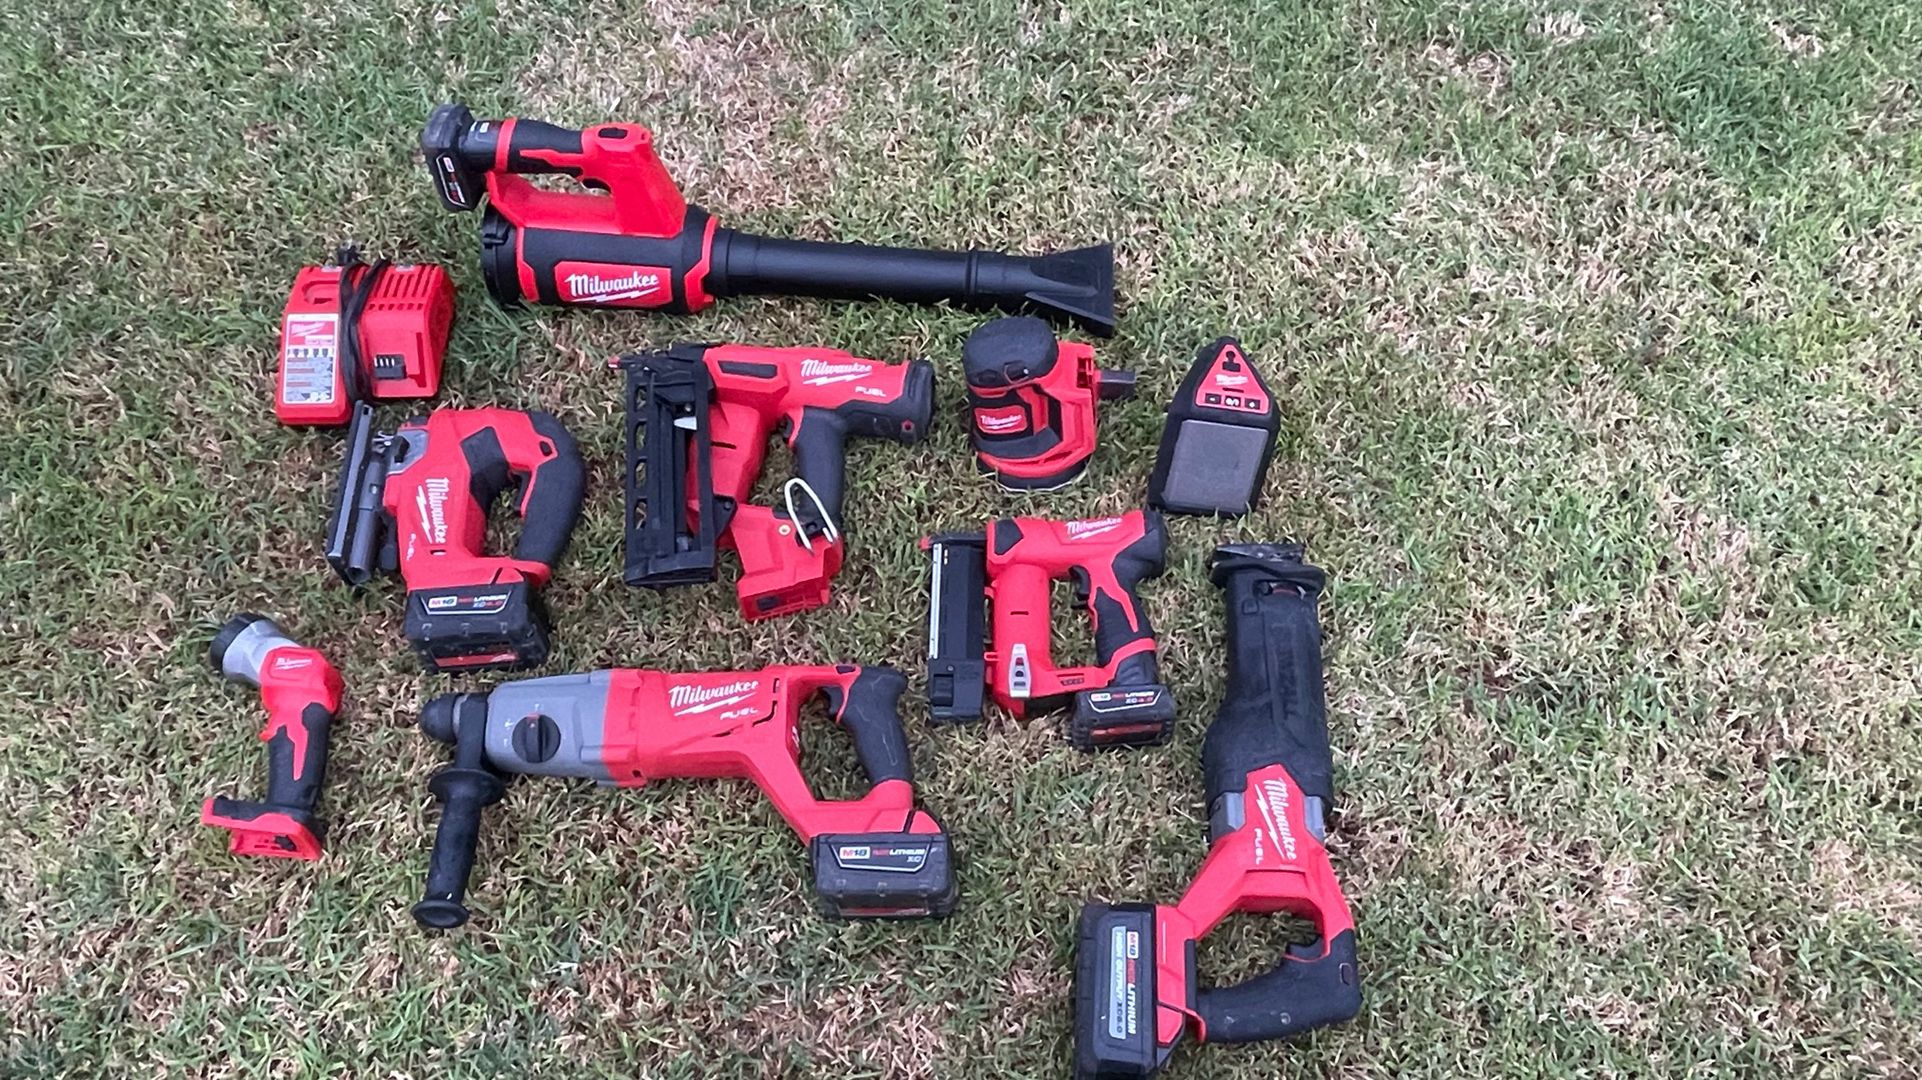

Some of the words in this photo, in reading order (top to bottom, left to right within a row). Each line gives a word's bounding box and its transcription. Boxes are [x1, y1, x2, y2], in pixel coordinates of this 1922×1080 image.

[564, 270, 660, 297] Milwaukee
[801, 359, 873, 377] Milwaukee
[668, 681, 759, 709] Milwaukee
[720, 707, 759, 720] FUEL
[1263, 776, 1297, 860] Milwaukee
[842, 848, 868, 858] M18
[1254, 829, 1264, 865] FUEL
[1115, 958, 1124, 1002] OUTPUT
